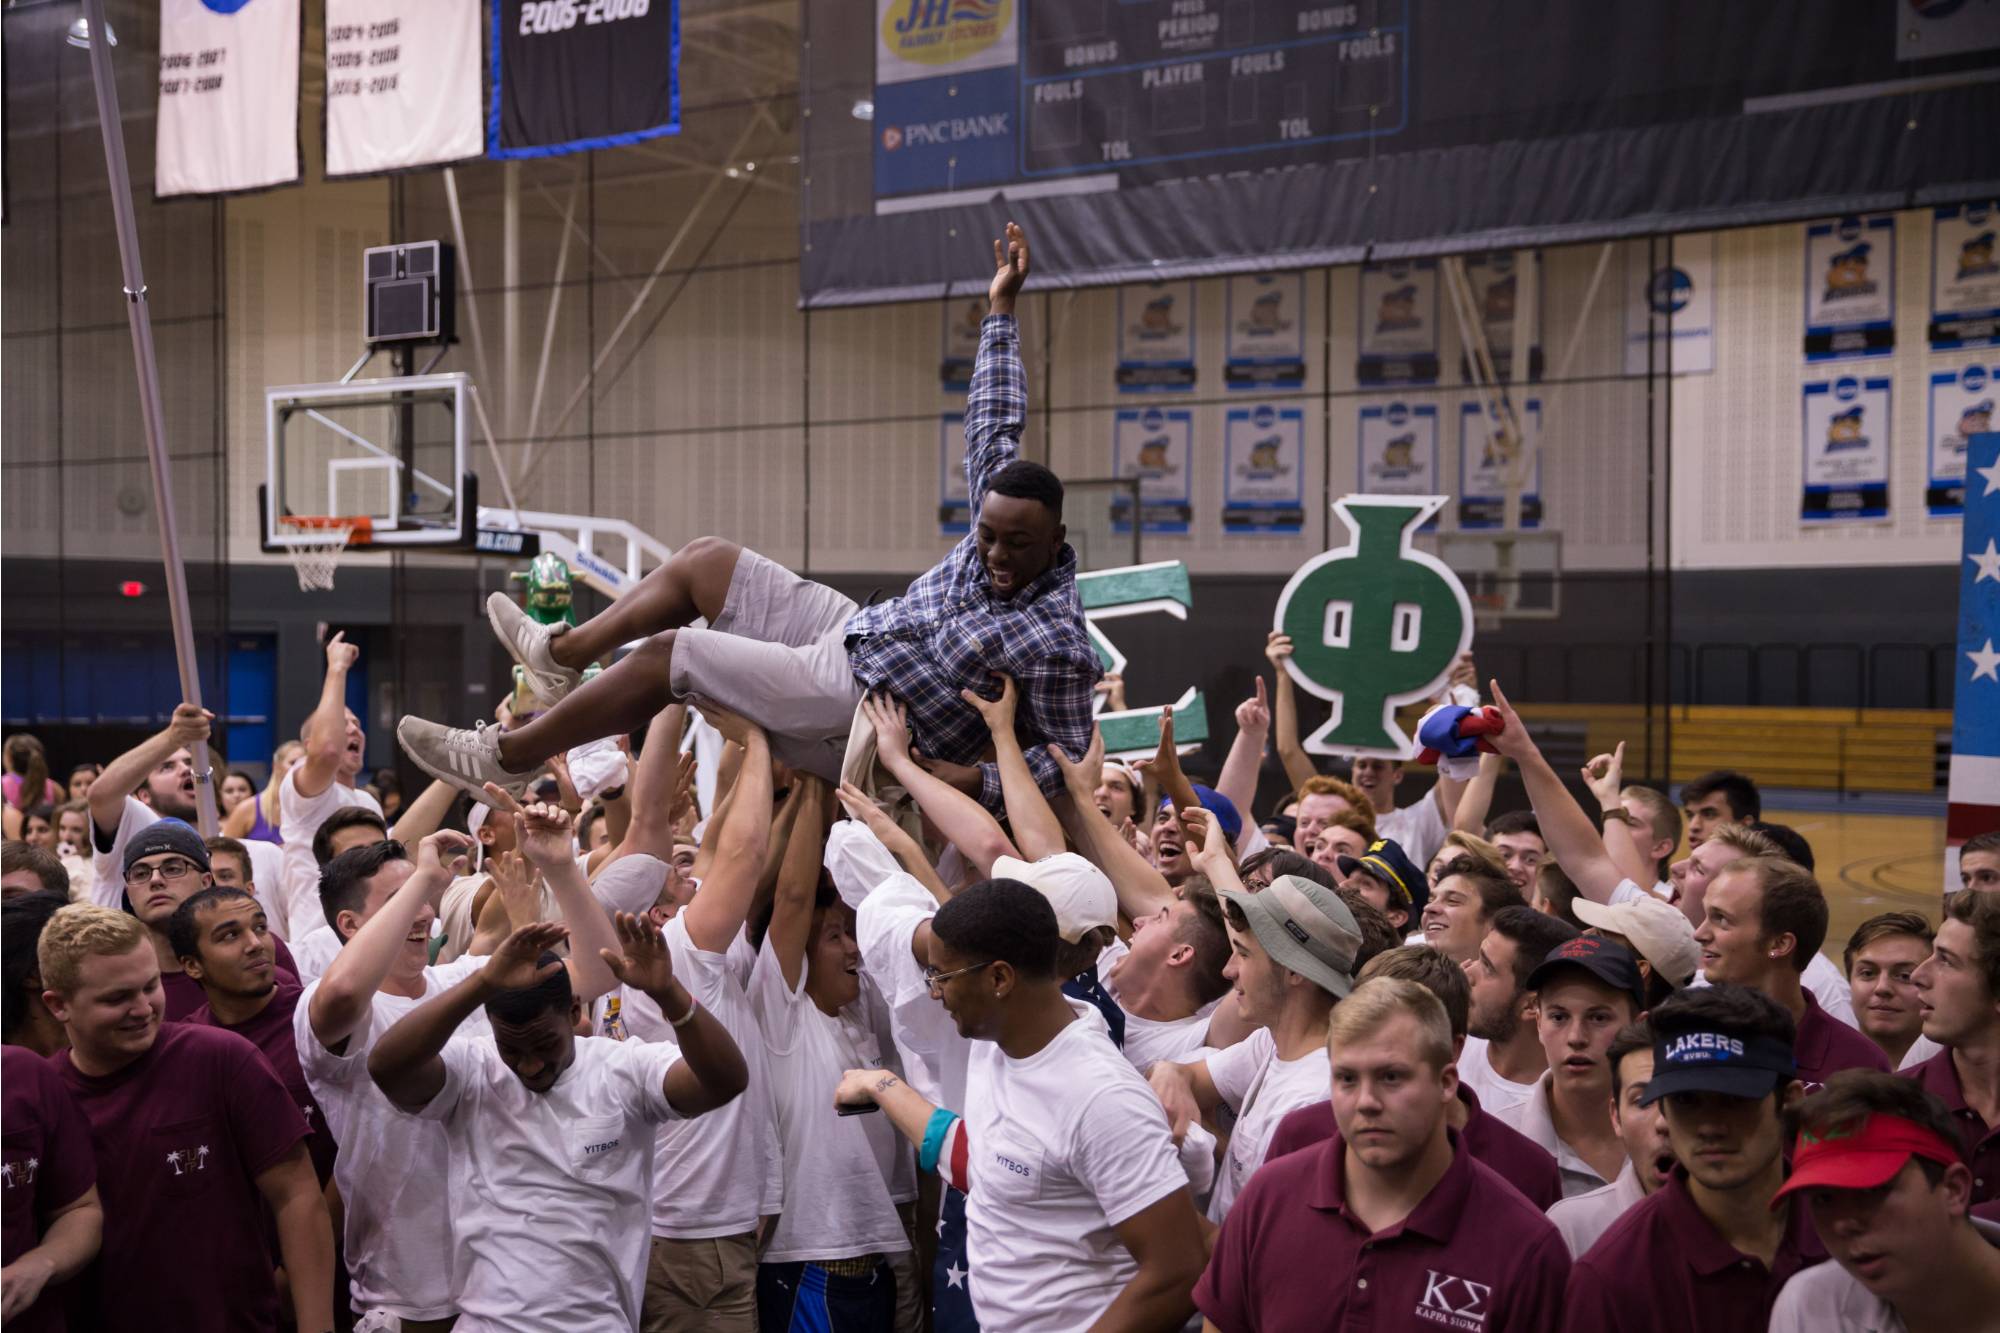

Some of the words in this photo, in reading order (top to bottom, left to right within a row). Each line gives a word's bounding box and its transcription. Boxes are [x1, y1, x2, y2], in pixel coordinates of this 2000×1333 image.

[1158, 12, 1219, 40] PERIOD
[1297, 5, 1357, 32] BONUS
[1064, 40, 1118, 68] BONUS
[1338, 34, 1395, 61] FOULS
[1142, 62, 1204, 89] PLAYER
[1230, 50, 1285, 77] FOULS
[1033, 79, 1084, 104] FOULS
[905, 121, 950, 147] PNC
[951, 112, 1009, 141] BANK
[1279, 117, 1312, 139] TOL
[1101, 140, 1132, 161] TOL
[1665, 1032, 1744, 1060] LAKERS
[584, 1139, 619, 1154] YITBOS
[995, 1152, 1030, 1177] YITBOS
[1414, 1305, 1448, 1324] KAPPA
[1449, 1316, 1483, 1333] SIGMA
